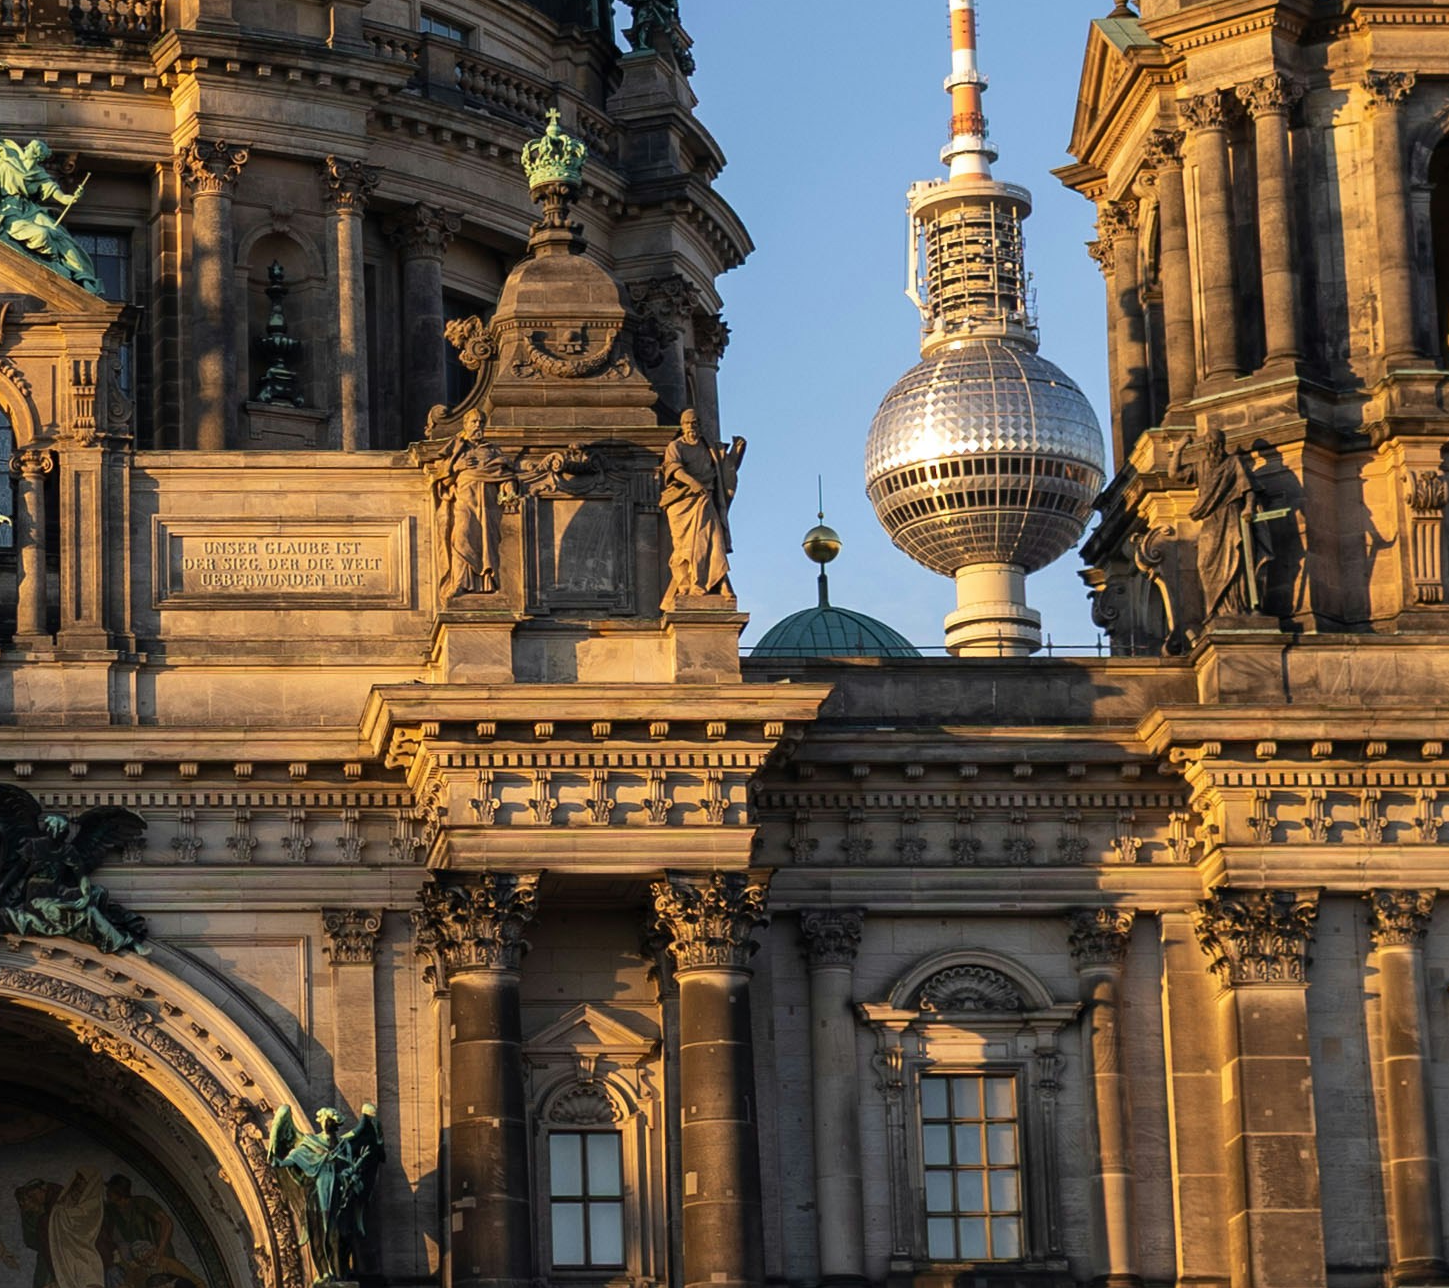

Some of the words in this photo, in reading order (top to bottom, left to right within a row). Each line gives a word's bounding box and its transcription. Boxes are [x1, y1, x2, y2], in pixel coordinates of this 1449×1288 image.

[203, 542, 258, 555] UNSER
[264, 542, 330, 555] GLAUBE
[334, 542, 362, 555] IST
[183, 558, 216, 571] DER
[221, 558, 263, 572] SIEG,
[267, 558, 300, 571] DER
[306, 558, 335, 571] DIE
[341, 558, 383, 571] WELT
[201, 574, 326, 587] UEBERWUNDEN
[333, 574, 366, 587] HAT.
